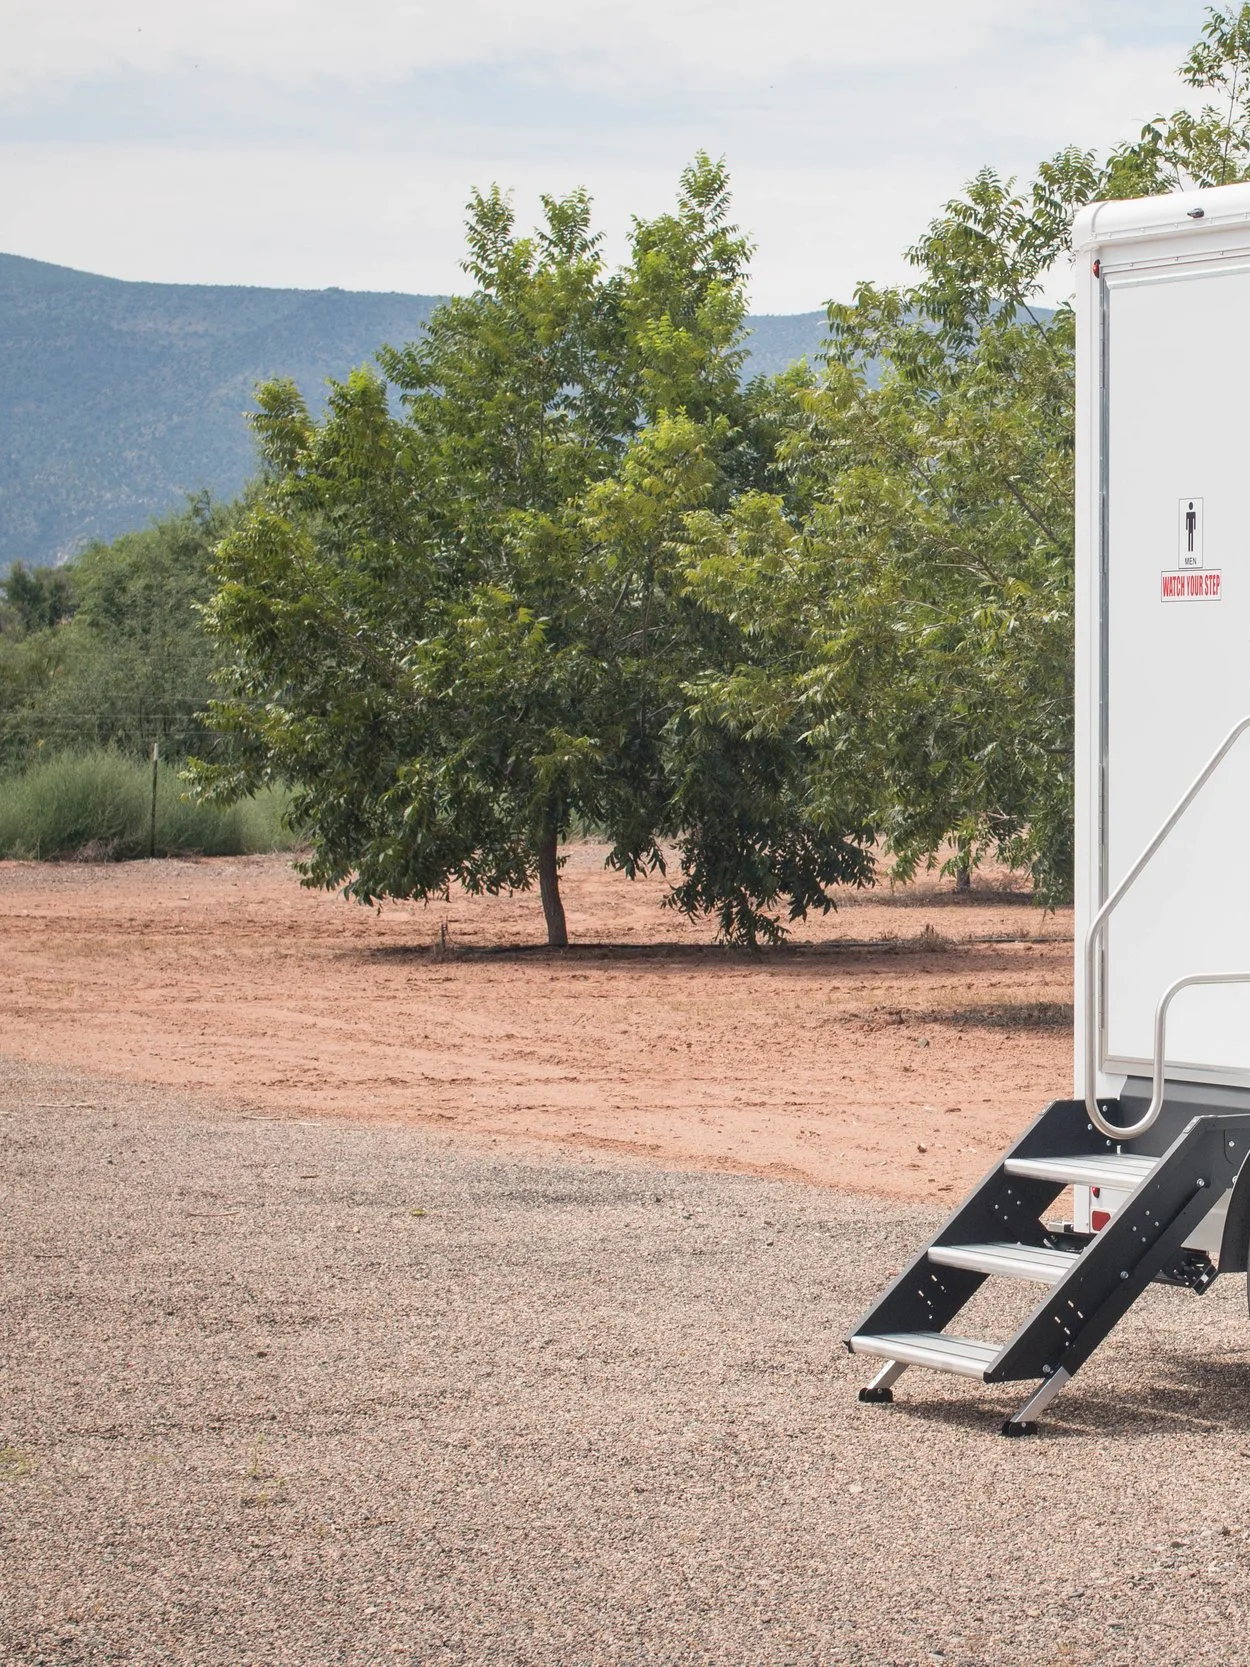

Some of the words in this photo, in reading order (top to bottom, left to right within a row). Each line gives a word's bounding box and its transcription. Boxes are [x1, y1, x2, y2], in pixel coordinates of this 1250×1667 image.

[1184, 557, 1197, 566] MEN
[1163, 576, 1185, 597] WATCH
[1187, 575, 1203, 596] YOUR
[1204, 574, 1220, 596] STEP
